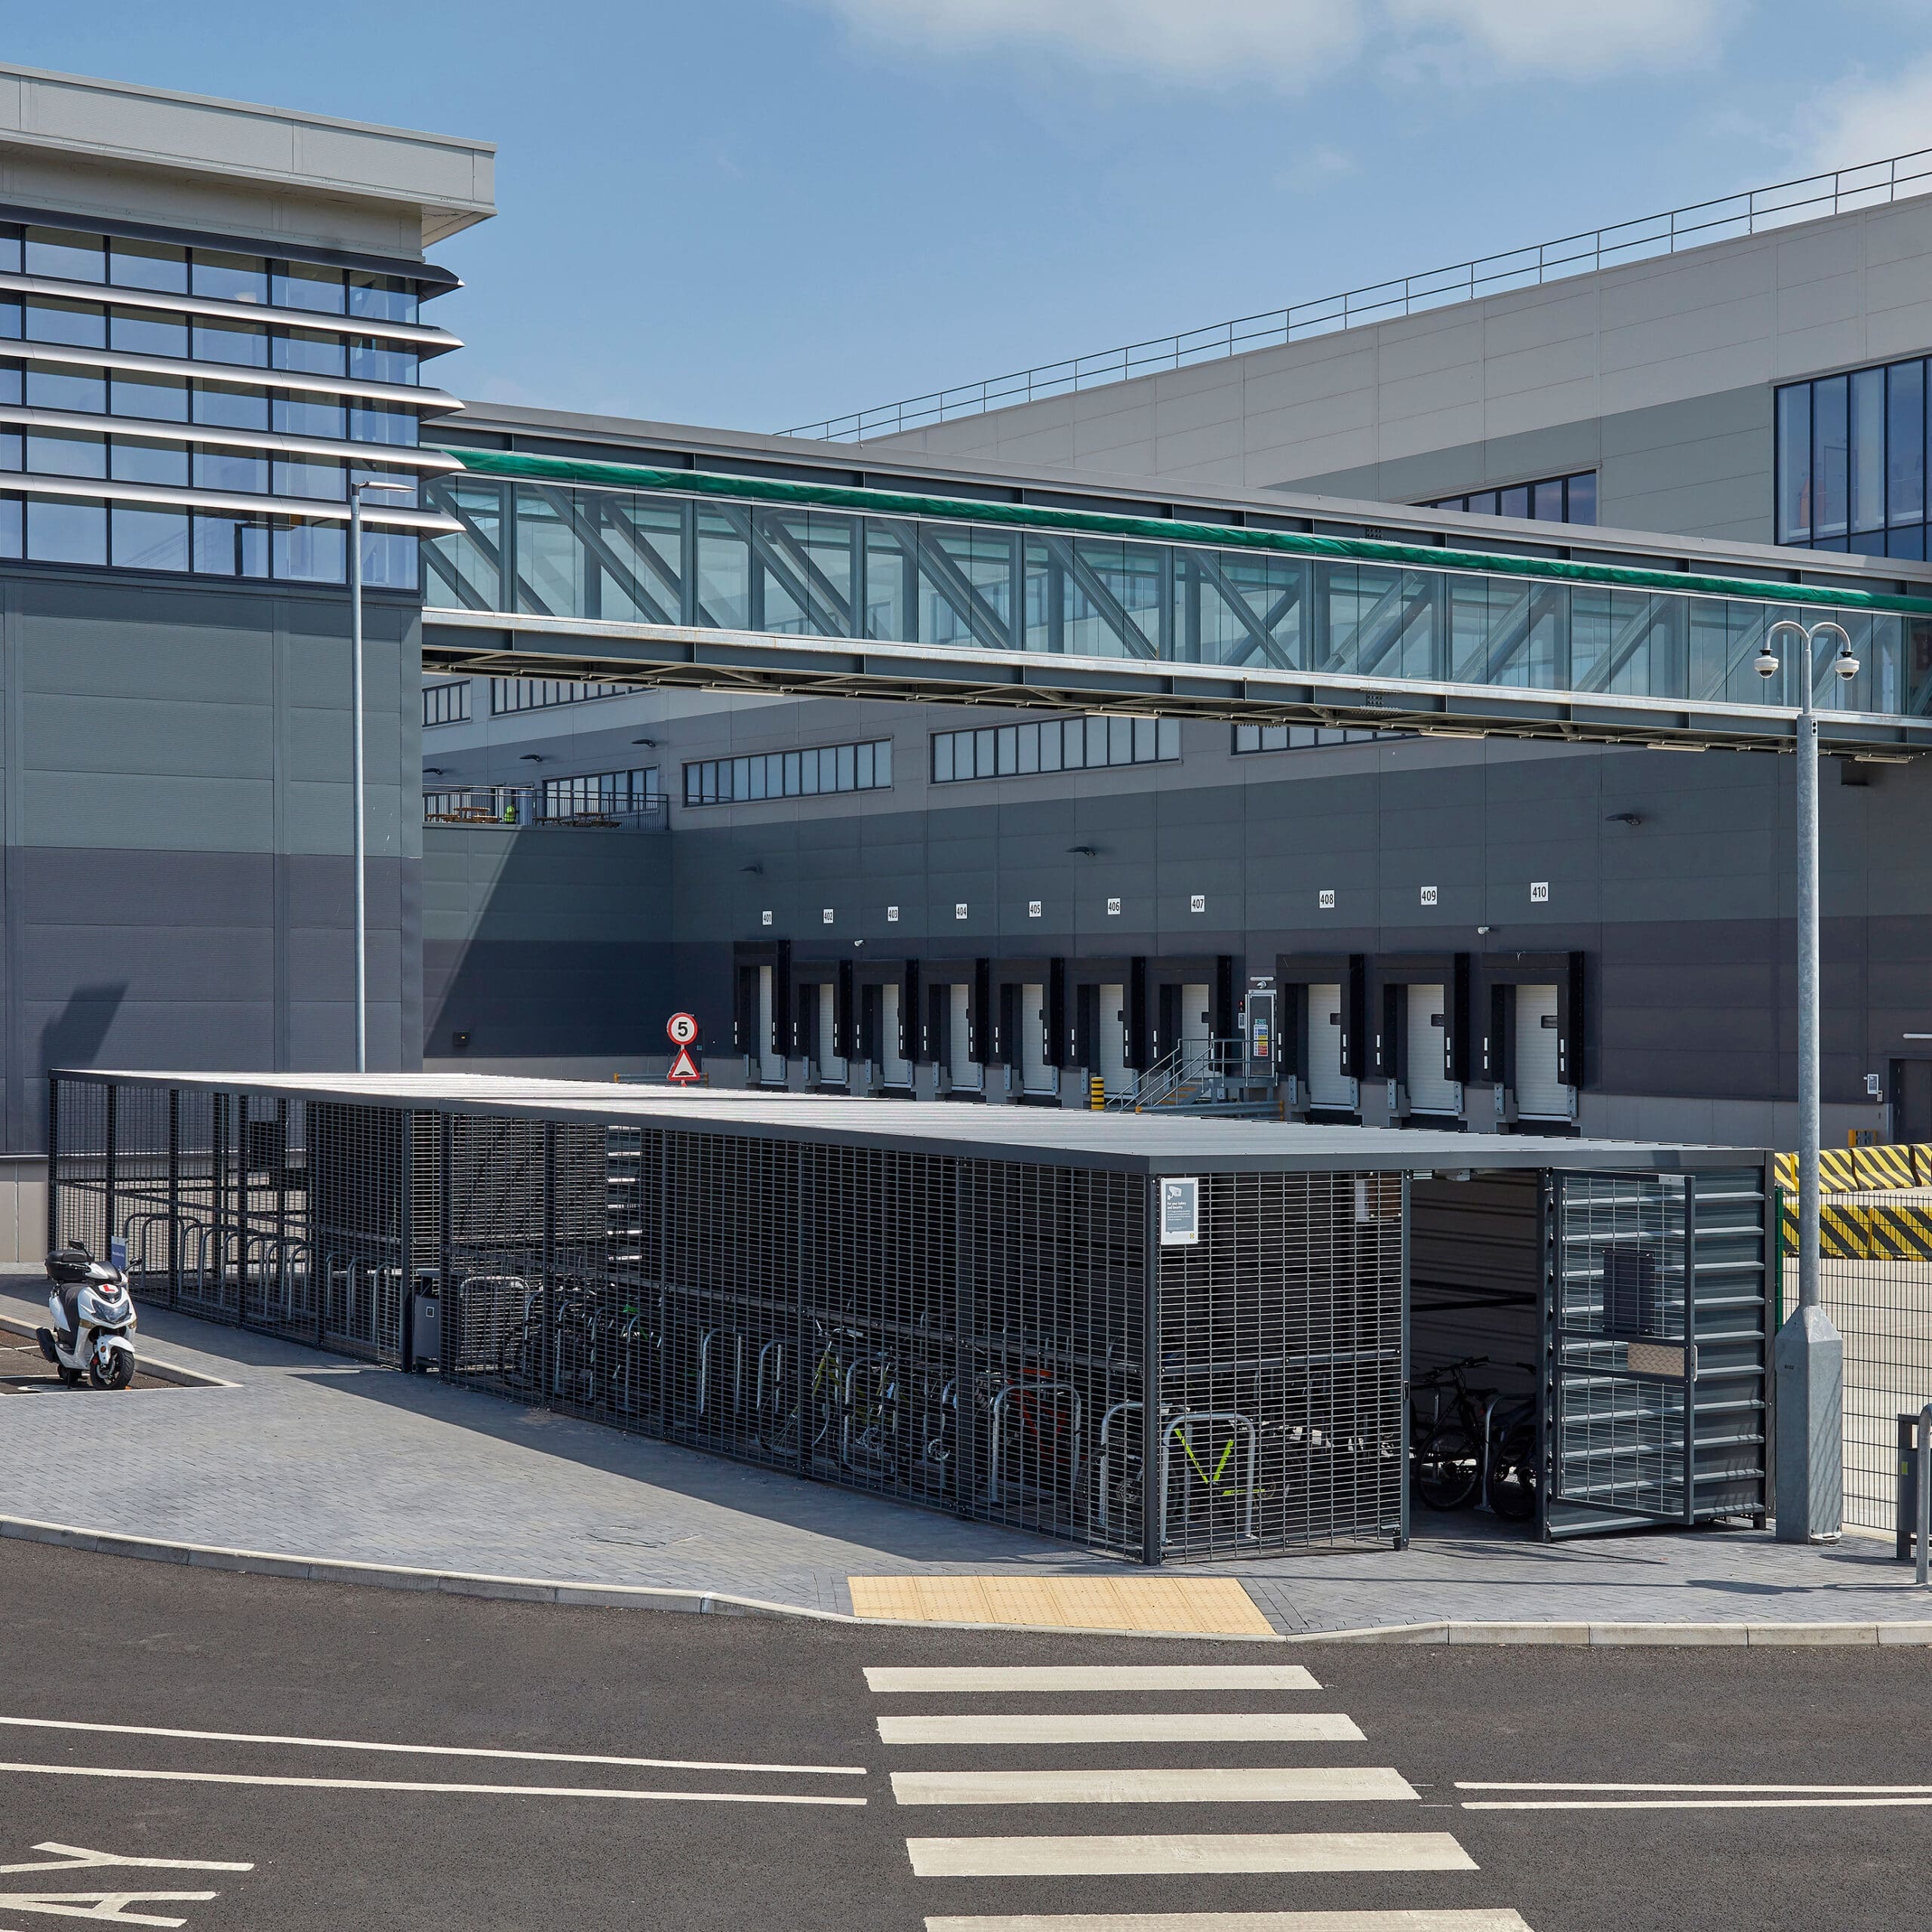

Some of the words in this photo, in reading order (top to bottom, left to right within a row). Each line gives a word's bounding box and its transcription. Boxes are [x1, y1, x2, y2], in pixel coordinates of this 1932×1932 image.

[1421, 890, 1436, 902] 409
[1532, 886, 1547, 898] 410
[1192, 899, 1204, 909] 407
[1320, 894, 1334, 905] 408
[956, 906, 967, 916] 404
[1029, 904, 1041, 914] 405
[1108, 901, 1120, 912] 406
[763, 914, 771, 923] 401
[824, 912, 833, 921] 402
[888, 909, 897, 918] 403
[678, 1021, 688, 1037] 5
[103, 1284, 115, 1293] L
[0, 1841, 255, 1932] AY
